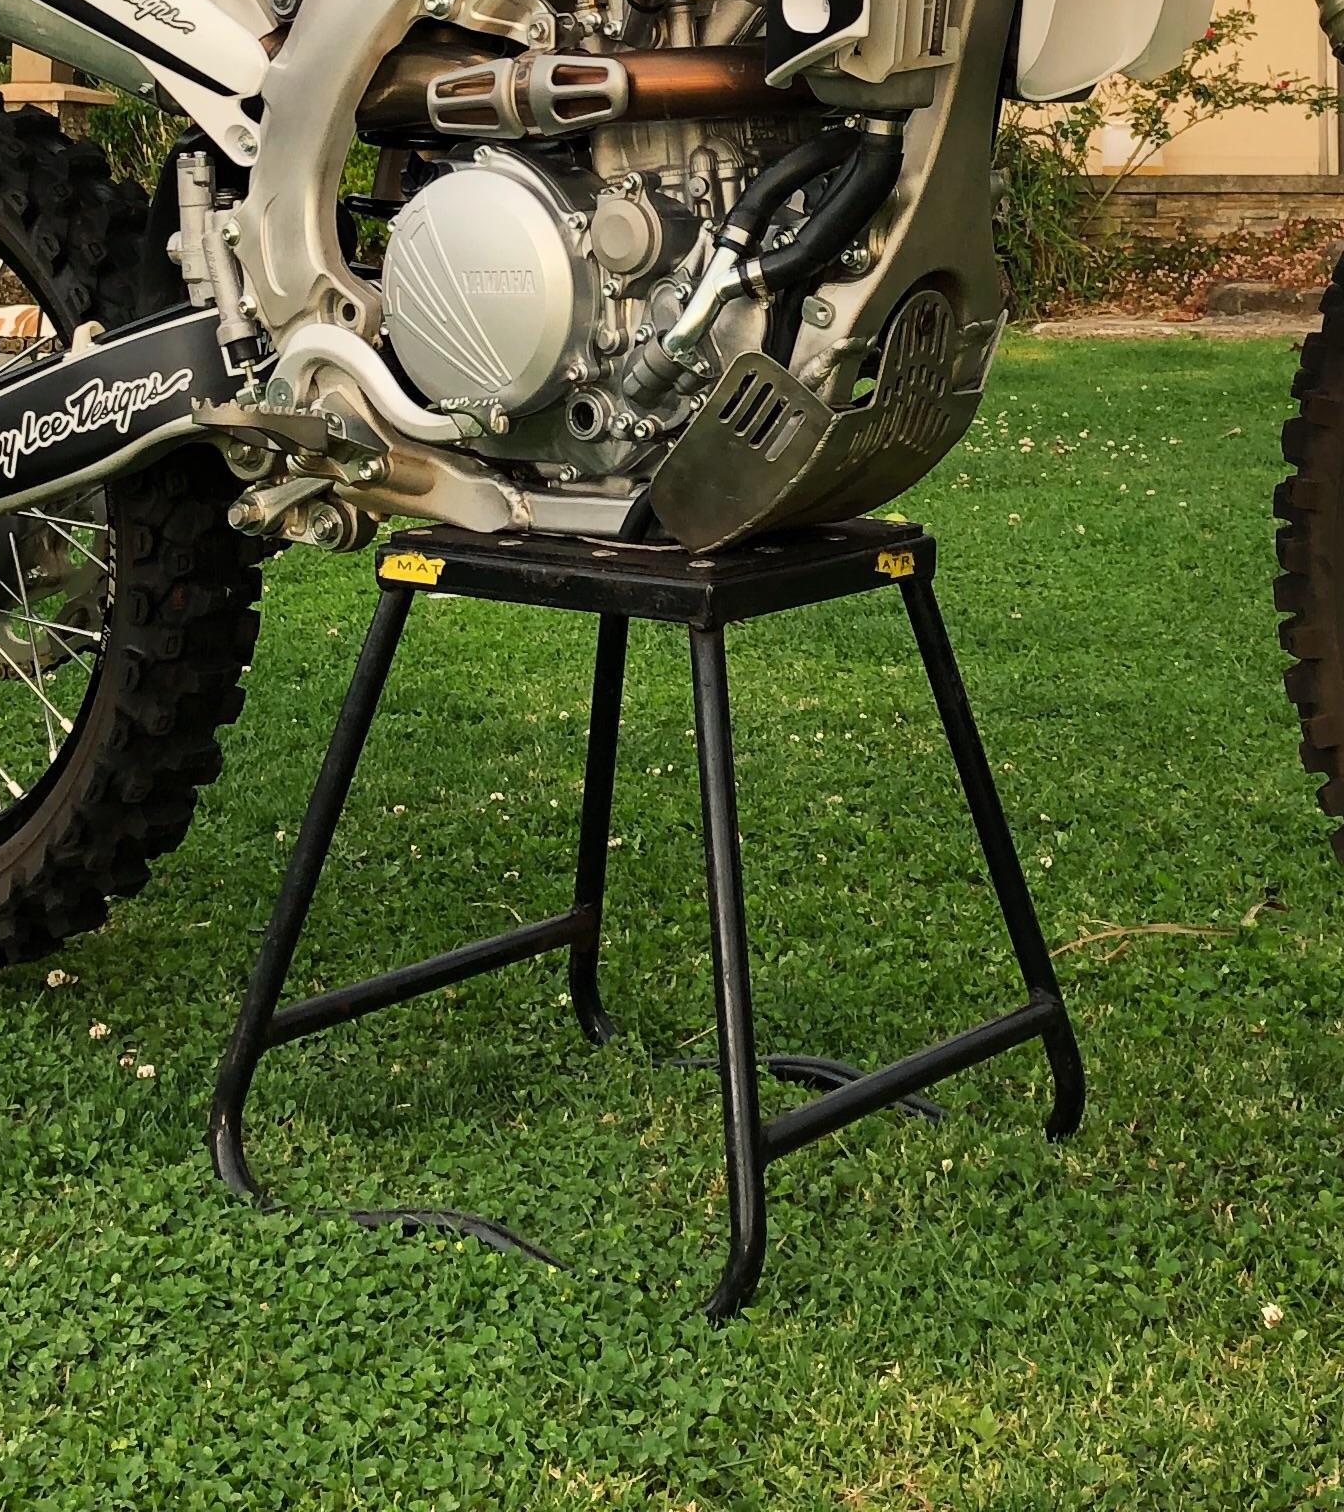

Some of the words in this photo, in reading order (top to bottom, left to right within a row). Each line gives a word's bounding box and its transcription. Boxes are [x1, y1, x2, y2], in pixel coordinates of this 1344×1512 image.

[462, 269, 536, 295] YAMAHA
[19, 410, 73, 456] Lee
[65, 367, 194, 434] Designs
[397, 559, 442, 575] MAT
